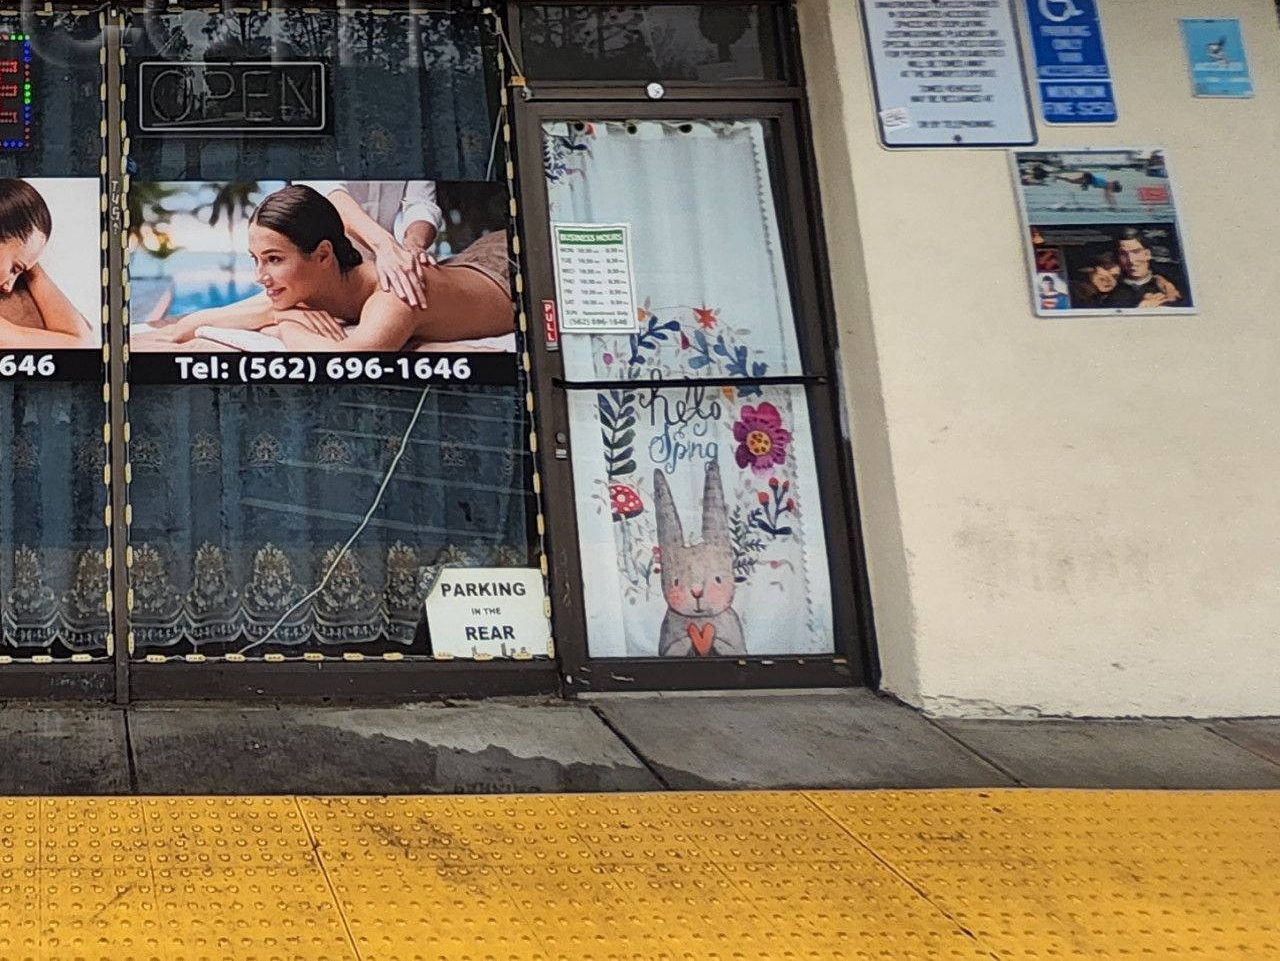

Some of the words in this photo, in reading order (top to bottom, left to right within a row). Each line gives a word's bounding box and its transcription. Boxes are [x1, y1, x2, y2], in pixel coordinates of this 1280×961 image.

[150, 69, 317, 122] OPEN
[544, 303, 555, 341] PULL
[175, 356, 230, 380] Tel:
[238, 356, 317, 383] (562)
[325, 357, 471, 380] 696-1646
[440, 582, 526, 597] PARKING
[471, 607, 482, 616] IN
[484, 607, 502, 615] THE
[465, 625, 516, 641] REAR
